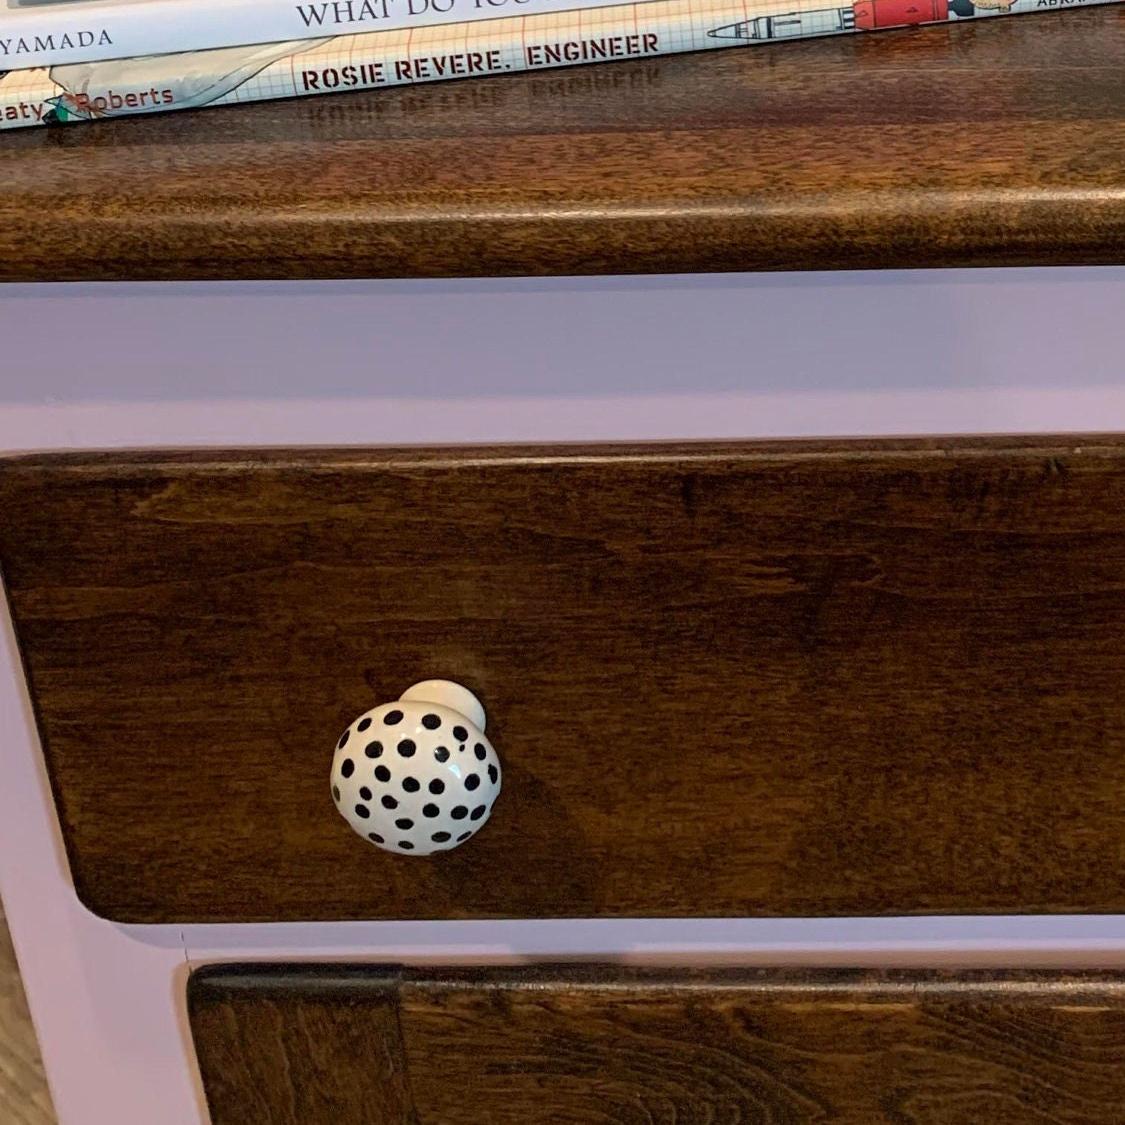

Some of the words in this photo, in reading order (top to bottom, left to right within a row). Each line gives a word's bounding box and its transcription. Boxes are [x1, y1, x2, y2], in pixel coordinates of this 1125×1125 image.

[0, 29, 113, 55] YAMADA
[75, 88, 174, 112] Roberts
[302, 63, 386, 92] ROSIE
[526, 32, 660, 66] ENGINEER
